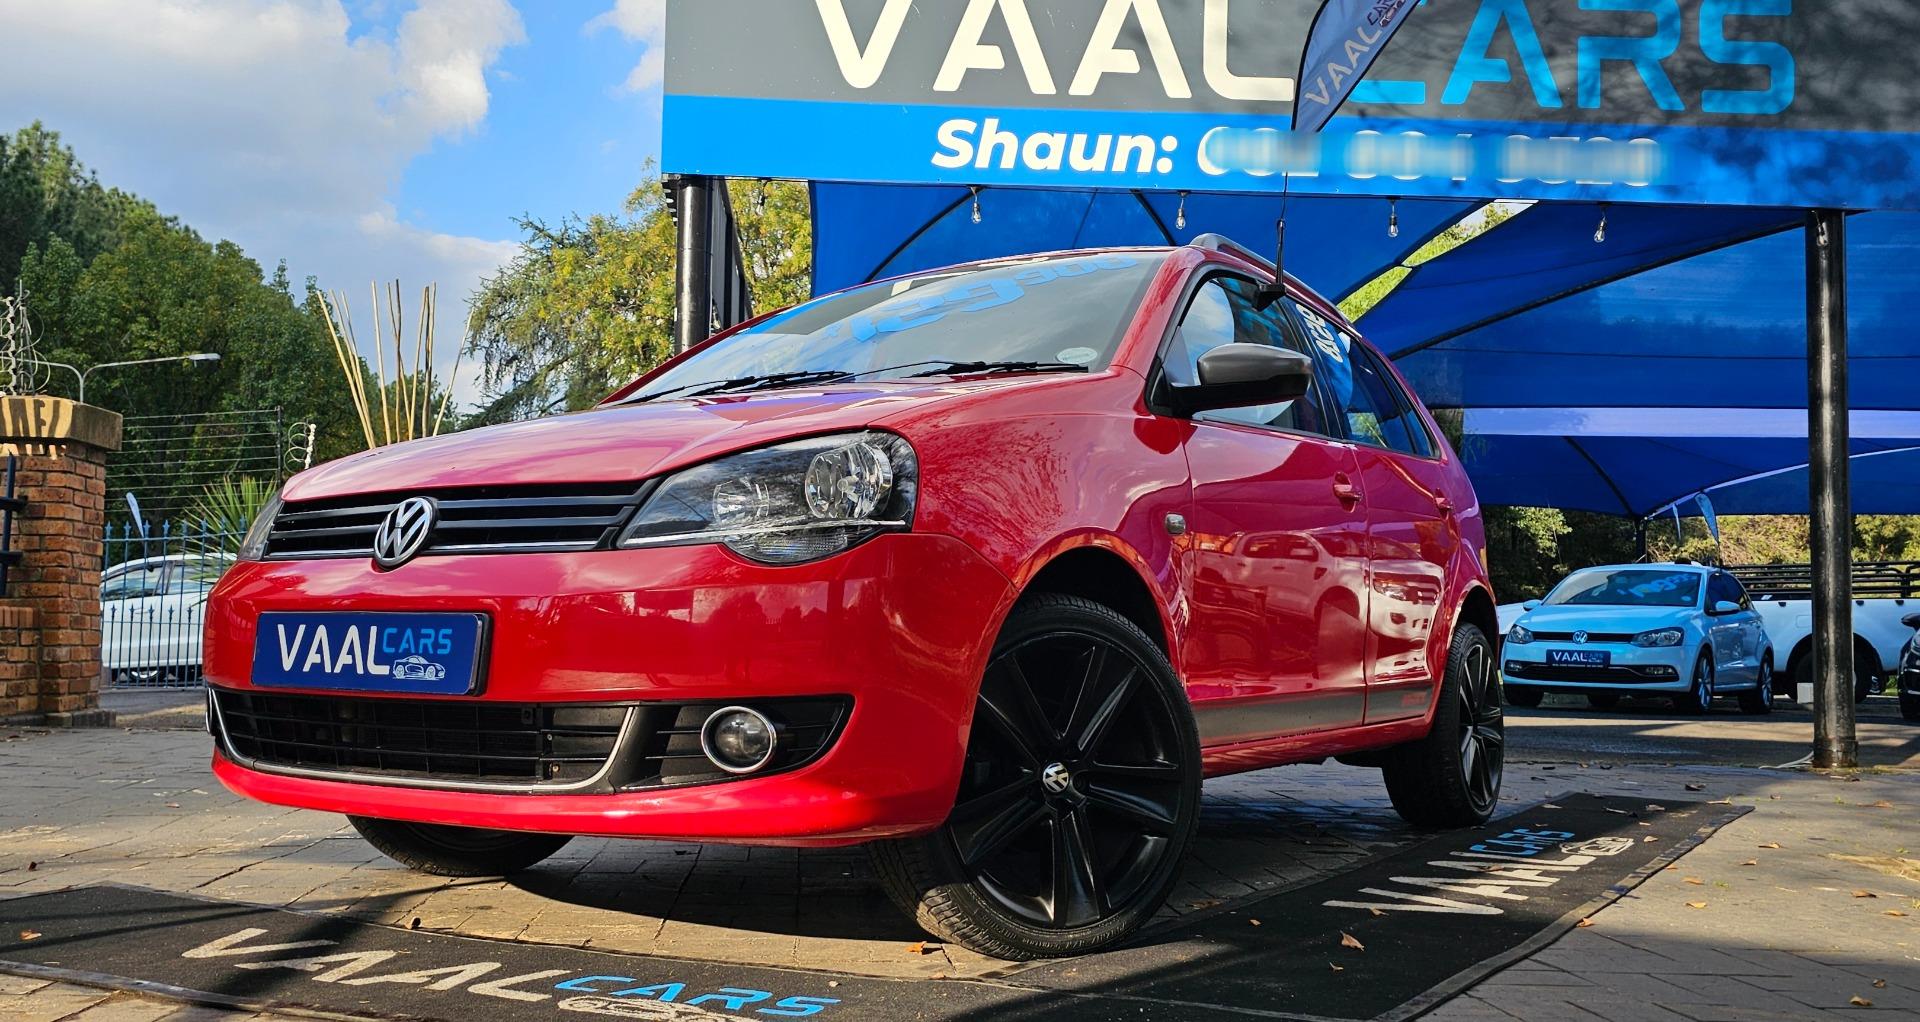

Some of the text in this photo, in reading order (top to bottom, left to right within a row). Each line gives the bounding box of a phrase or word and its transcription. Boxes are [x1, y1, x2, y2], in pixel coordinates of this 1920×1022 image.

[817, 0, 1795, 114] VAAL ARS
[1304, 26, 1383, 105] VAAL
[931, 117, 1178, 175] Shaun:
[277, 623, 453, 676] VAAL CARS
[1552, 650, 1588, 662] VAAL
[1322, 828, 1597, 915] VAAL CARS
[182, 928, 842, 1017] VAAL CARS
